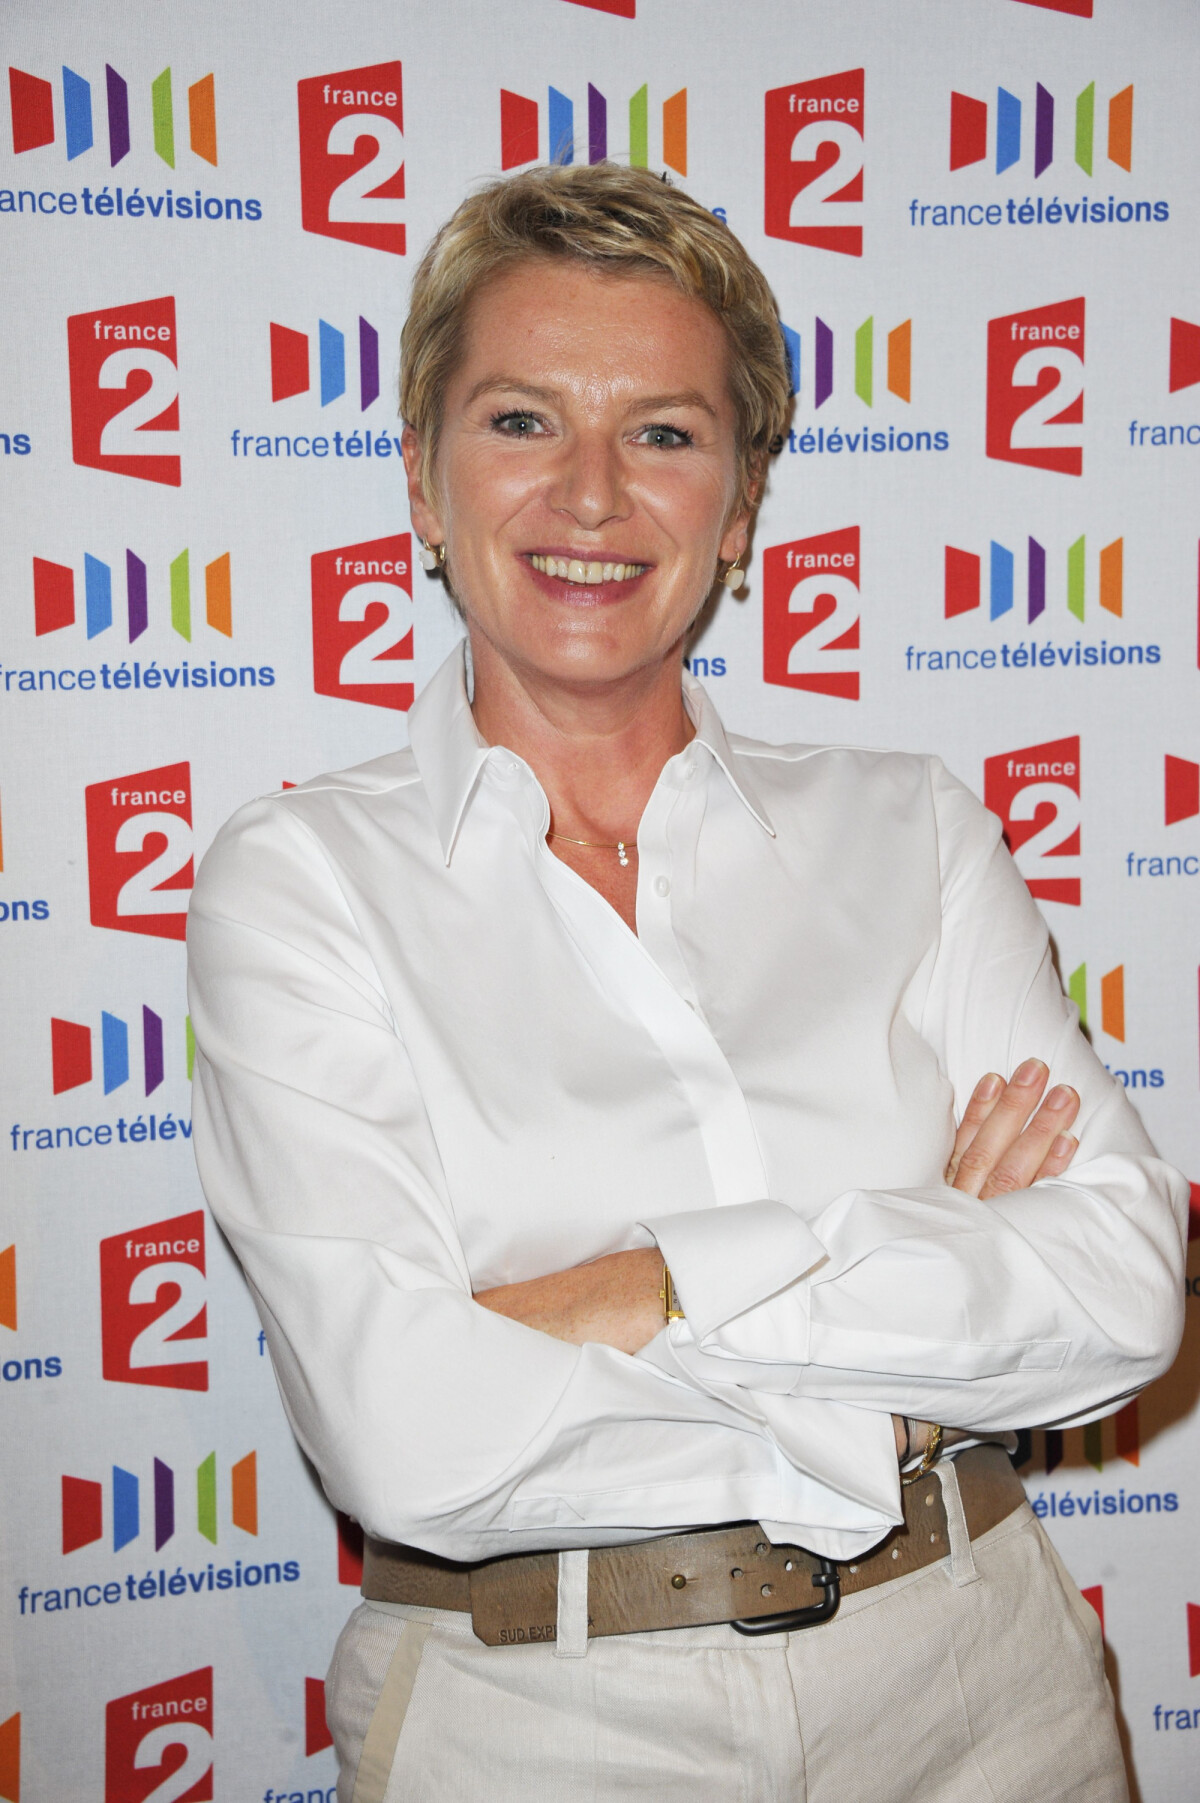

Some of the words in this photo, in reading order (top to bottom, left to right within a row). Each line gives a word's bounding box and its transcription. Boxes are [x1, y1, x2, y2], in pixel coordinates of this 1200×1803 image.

[323, 85, 397, 106] france
[789, 95, 859, 112] france
[327, 113, 404, 224] 2
[789, 120, 864, 227] 2
[94, 321, 170, 340] france
[1011, 323, 1080, 340] france
[99, 348, 180, 455] 2
[1010, 347, 1084, 449] 2
[336, 558, 407, 575] france
[787, 551, 855, 568] france
[339, 582, 414, 685] 2
[787, 574, 860, 674] 2
[1007, 760, 1076, 777] france
[111, 788, 186, 805] france
[1010, 782, 1080, 881] 2
[116, 812, 195, 916] 2
[126, 1240, 200, 1258] france
[129, 1261, 207, 1369] 2
[500, 1628, 525, 1642] SUD
[132, 1698, 207, 1720] france
[134, 1722, 213, 1803] 2
